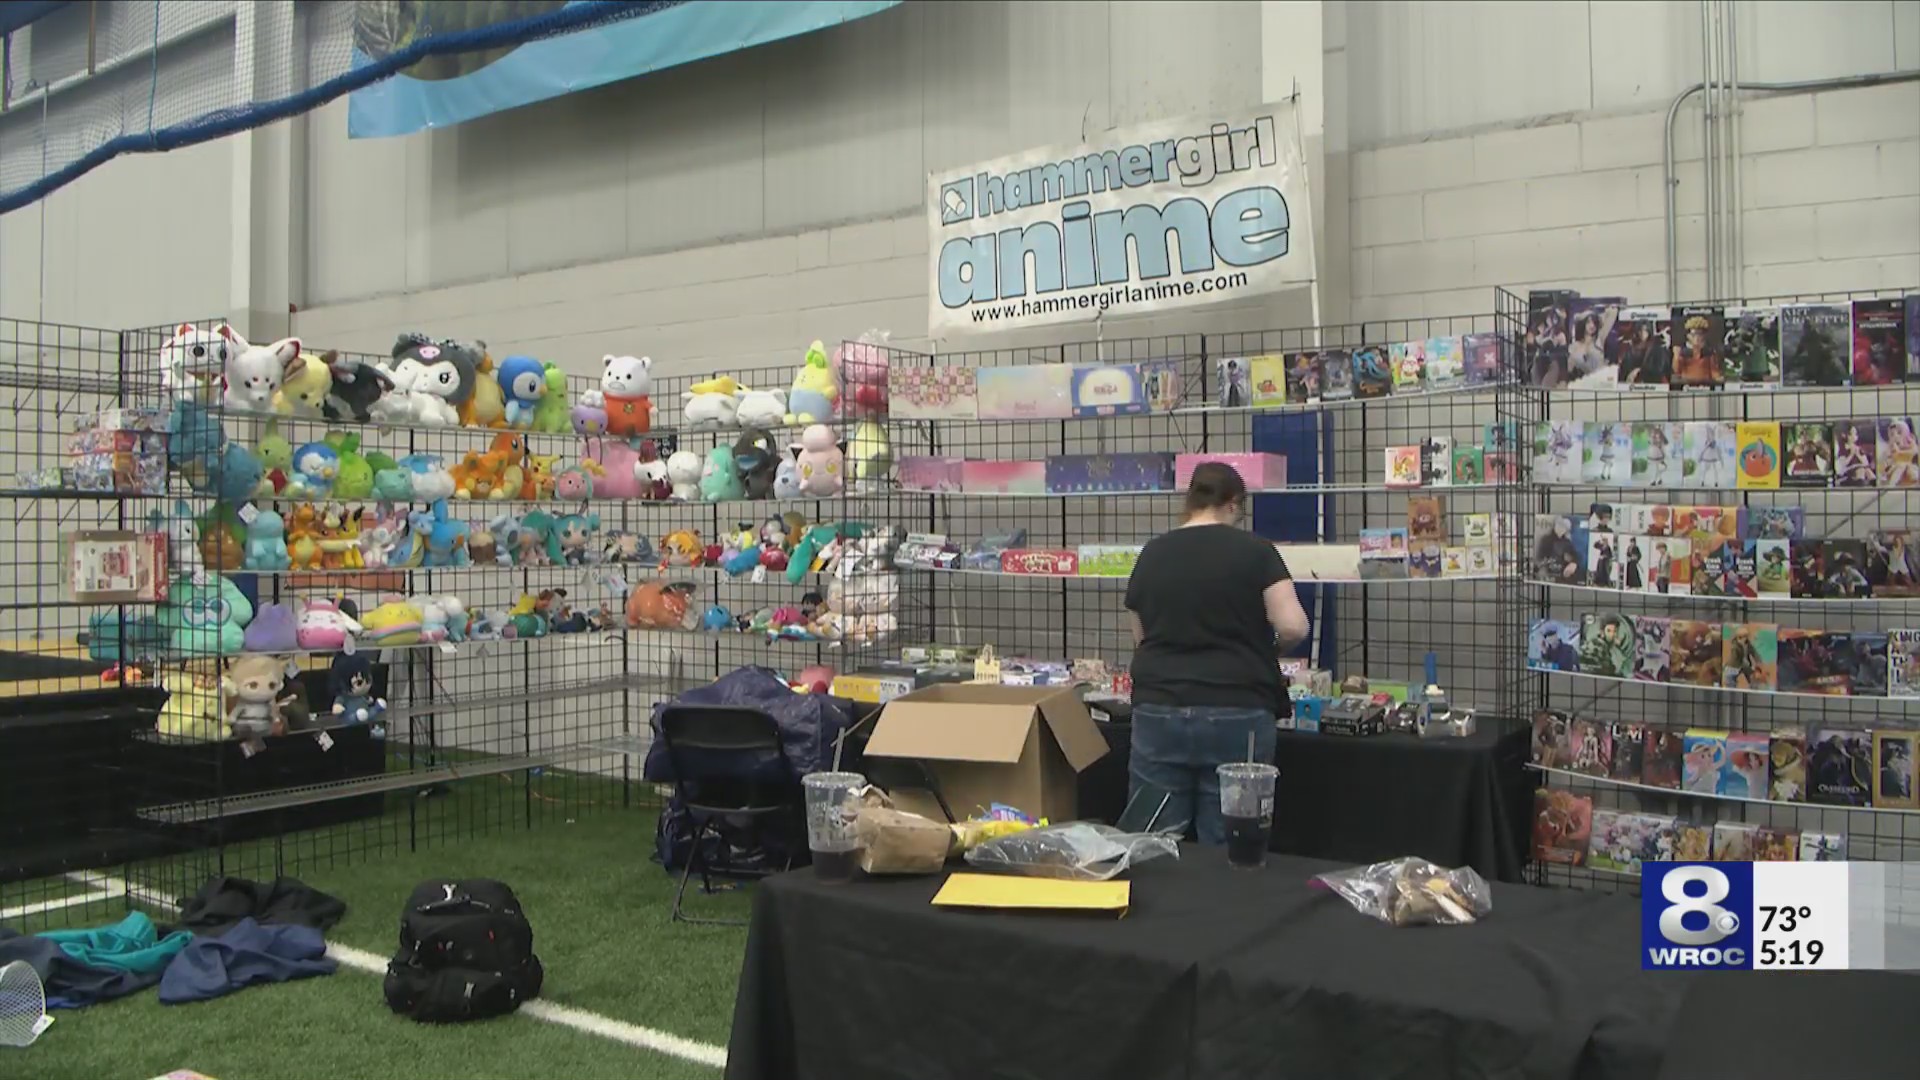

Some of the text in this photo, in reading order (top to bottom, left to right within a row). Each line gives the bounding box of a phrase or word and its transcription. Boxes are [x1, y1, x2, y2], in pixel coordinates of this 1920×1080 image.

[976, 115, 1278, 218] hammergirl
[937, 185, 1291, 309] anime
[970, 270, 1249, 323] www.hammergirlanime.com
